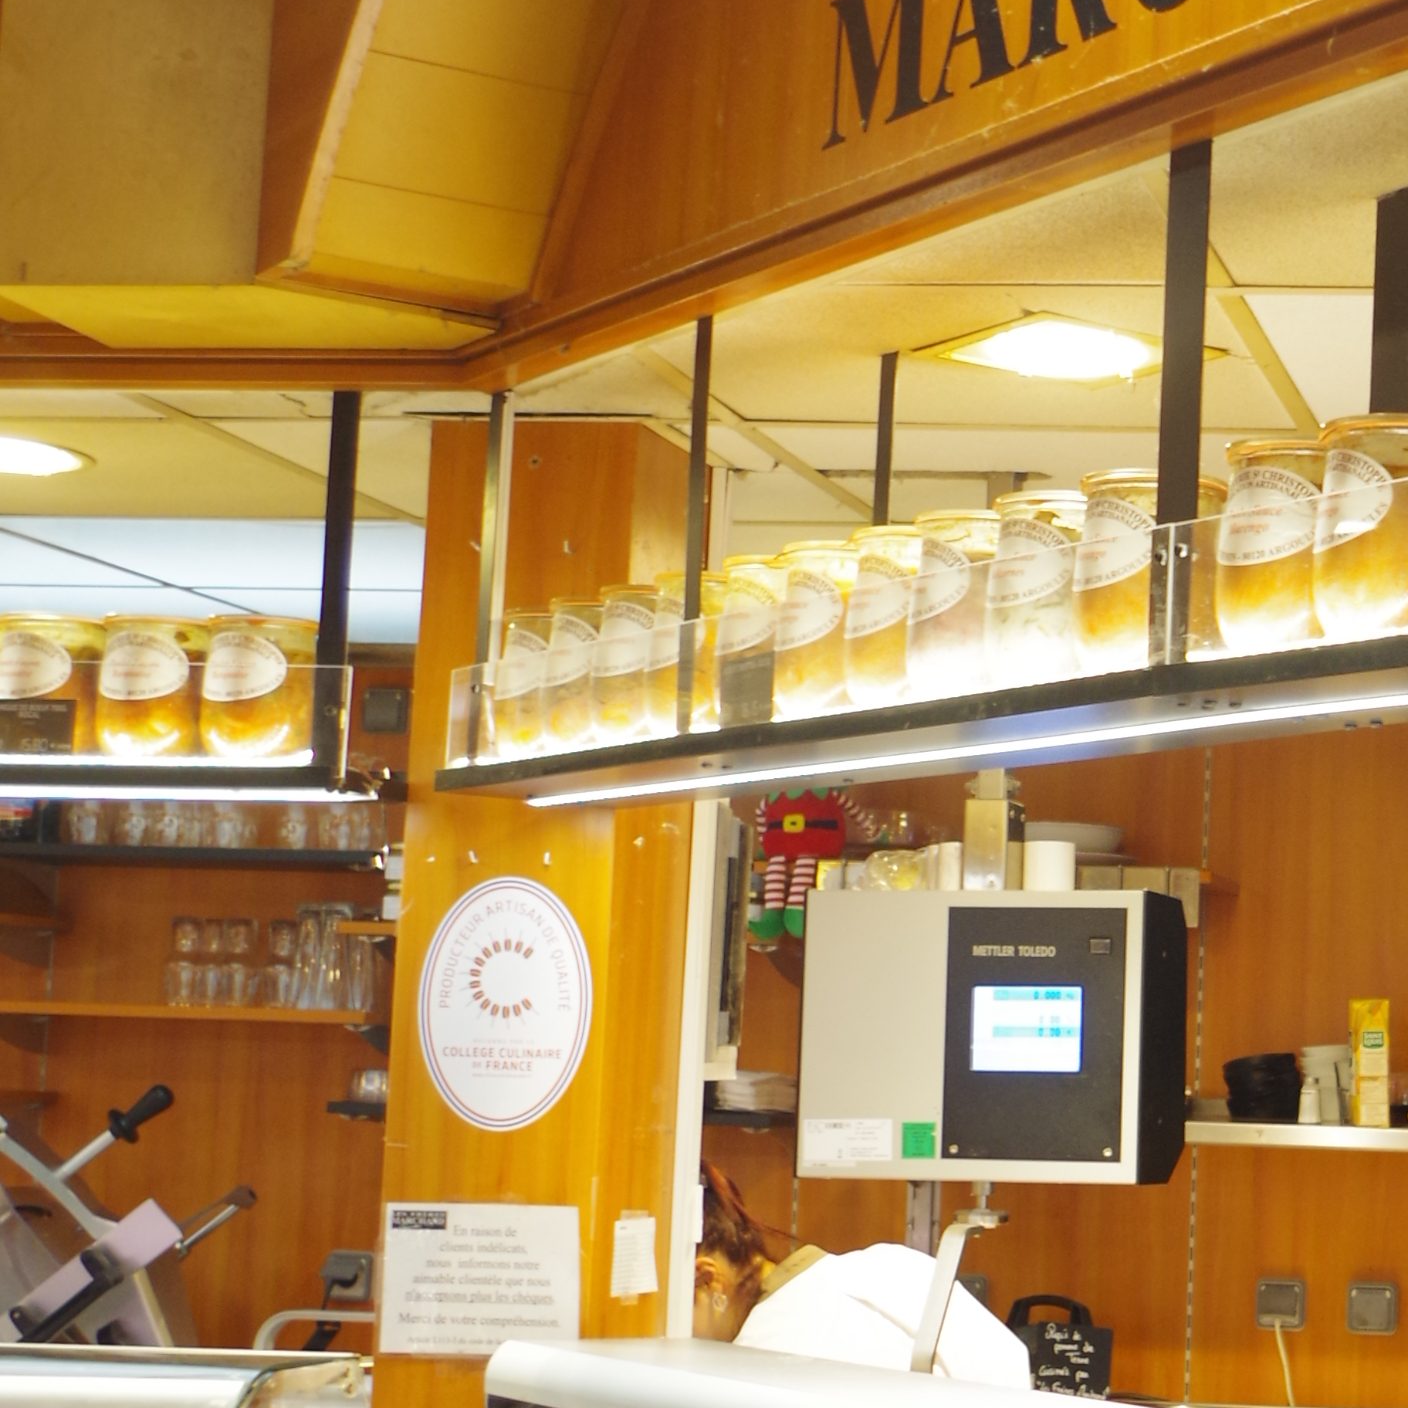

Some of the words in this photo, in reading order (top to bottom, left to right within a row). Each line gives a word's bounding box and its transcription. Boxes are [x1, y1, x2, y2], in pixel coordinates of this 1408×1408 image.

[438, 912, 485, 1009] PRODUCTEUR
[485, 899, 544, 929] ARTISAN
[542, 924, 558, 946] DE
[971, 944, 1015, 957] METTLER
[1017, 945, 1057, 958] TOLEDO
[498, 1048, 563, 1060] CULINAIRE
[485, 1061, 533, 1073] FRANCE
[503, 1226, 518, 1238] de
[398, 1312, 432, 1325] Merci
[433, 1313, 447, 1325] de
